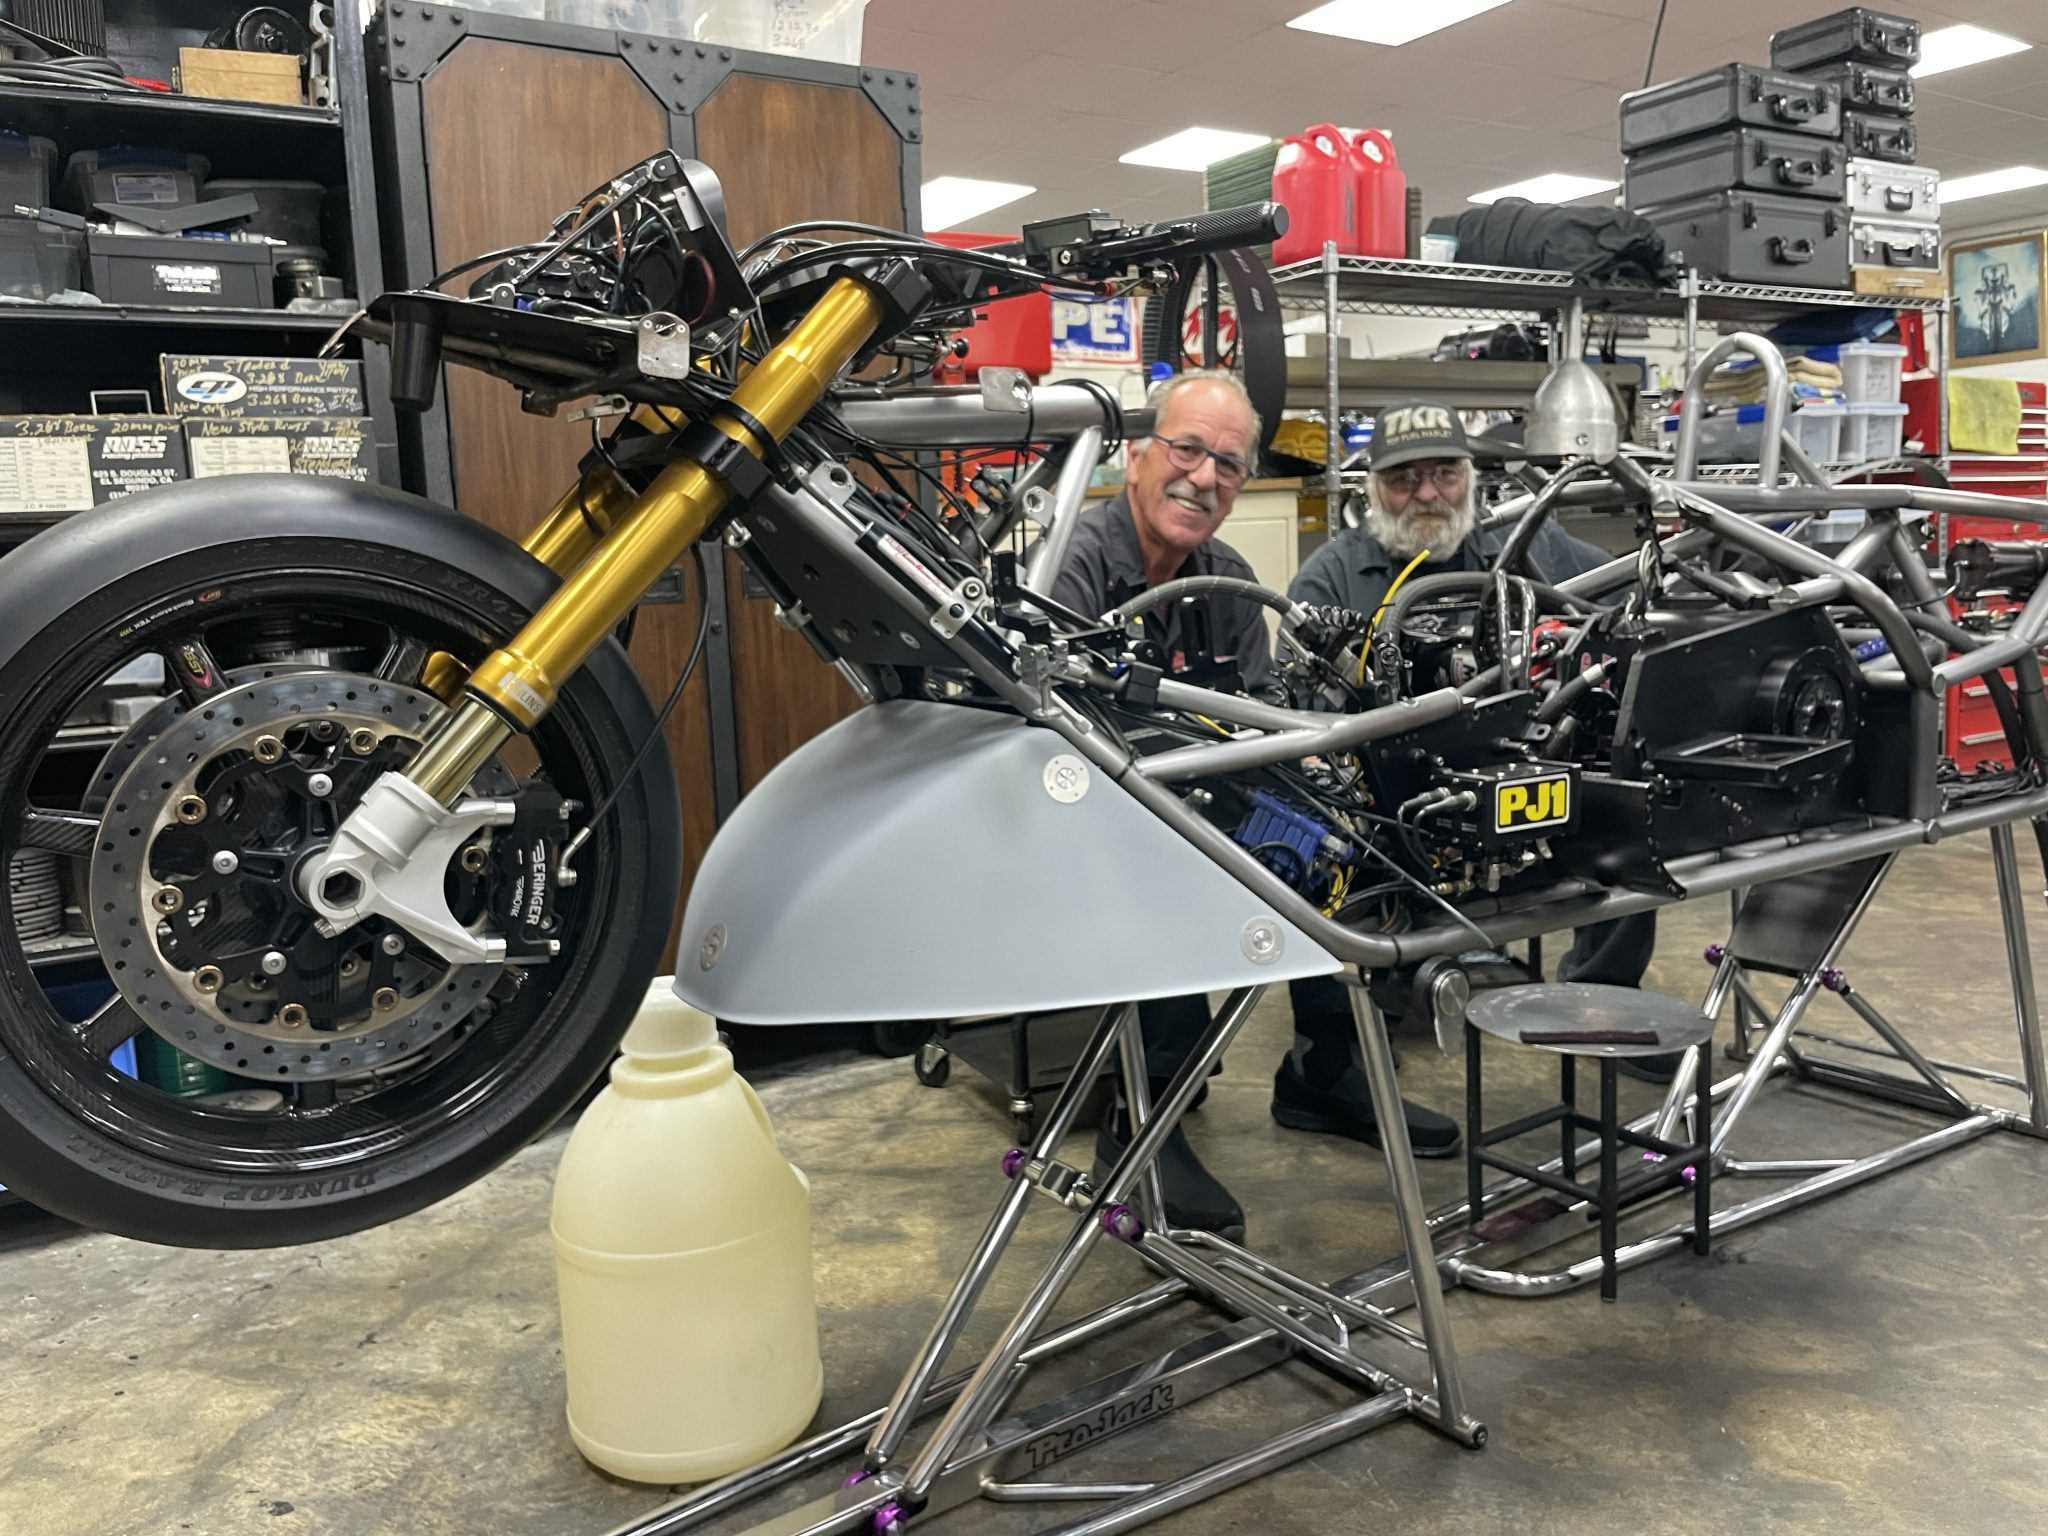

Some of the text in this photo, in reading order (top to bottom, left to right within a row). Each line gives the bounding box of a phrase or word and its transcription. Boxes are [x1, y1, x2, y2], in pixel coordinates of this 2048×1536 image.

[1384, 406, 1452, 438] TKR
[120, 469, 163, 478] DOUGLAS
[1499, 779, 1567, 827] PJ1
[526, 838, 546, 926] BERINGER
[223, 1167, 378, 1202] DUNLOP
